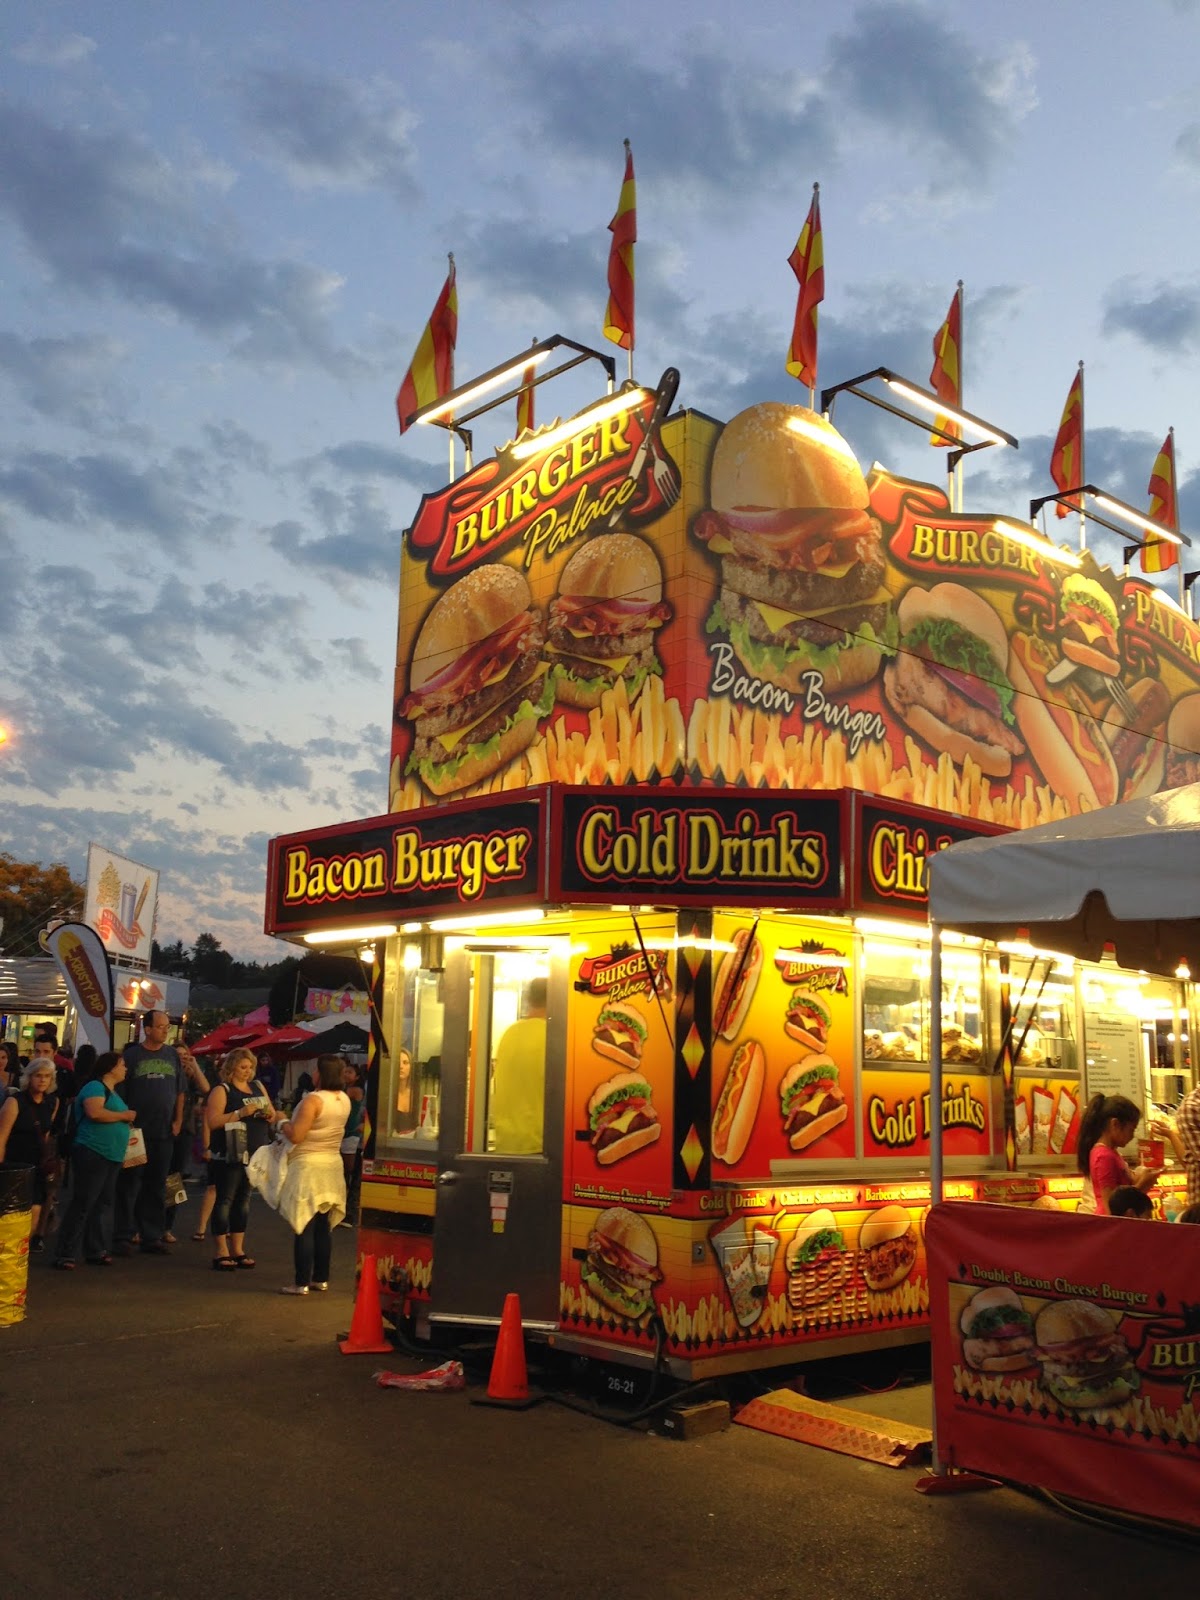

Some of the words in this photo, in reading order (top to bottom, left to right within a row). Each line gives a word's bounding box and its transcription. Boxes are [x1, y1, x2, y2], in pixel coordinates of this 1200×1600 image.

[451, 408, 631, 559] BURGER
[523, 478, 637, 568] Palace
[911, 524, 1039, 576] BURGER
[710, 643, 795, 713] Bacon
[802, 671, 886, 755] Burger
[286, 850, 385, 899] Bacon
[394, 832, 528, 896] Burger
[583, 812, 676, 876] Cold
[688, 815, 821, 879] Drinks
[872, 827, 930, 892] Chi
[595, 953, 658, 987] BURGER
[609, 979, 646, 1003] Palace
[870, 1097, 917, 1144] Cold
[700, 1195, 724, 1210] Cold
[735, 1193, 767, 1208] Drinks
[780, 1192, 814, 1206] Chicken
[814, 1189, 854, 1204] Sandwich
[865, 1188, 900, 1201] Barbecue
[901, 1185, 932, 1199] Sandwic
[972, 1264, 1011, 1284] Double
[1014, 1271, 1051, 1290] Bacon
[1054, 1278, 1099, 1297] Cheese
[1102, 1284, 1148, 1306] Burger
[1152, 1342, 1198, 1366] BU
